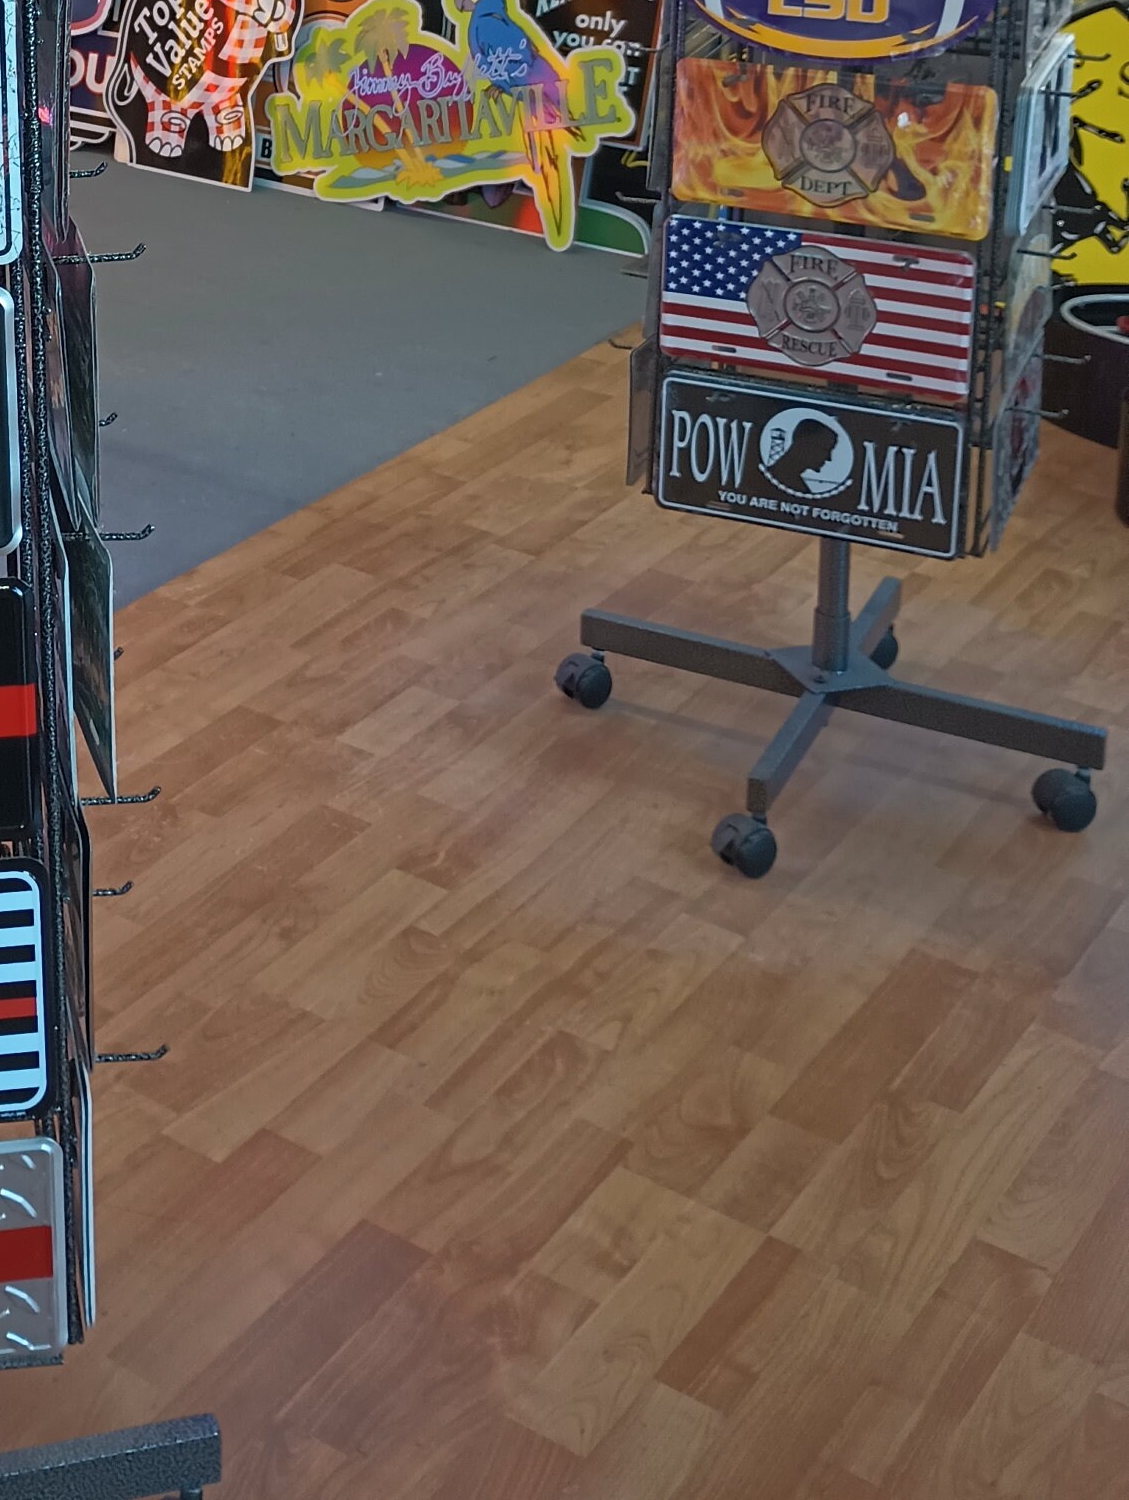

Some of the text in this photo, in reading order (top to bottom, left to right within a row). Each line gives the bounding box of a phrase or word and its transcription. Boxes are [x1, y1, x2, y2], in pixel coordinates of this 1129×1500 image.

[575, 11, 627, 37] only
[553, 30, 595, 49] you
[172, 17, 224, 90] STAMPS
[332, 66, 419, 136] Jimmy
[805, 94, 855, 115] FIRE
[799, 176, 851, 197] DEPT
[789, 254, 839, 278] FIRE
[781, 334, 838, 359] RESCUE
[670, 409, 947, 524] POW MIA
[718, 490, 898, 534] YOU ARE NOT FORGOTTEN
